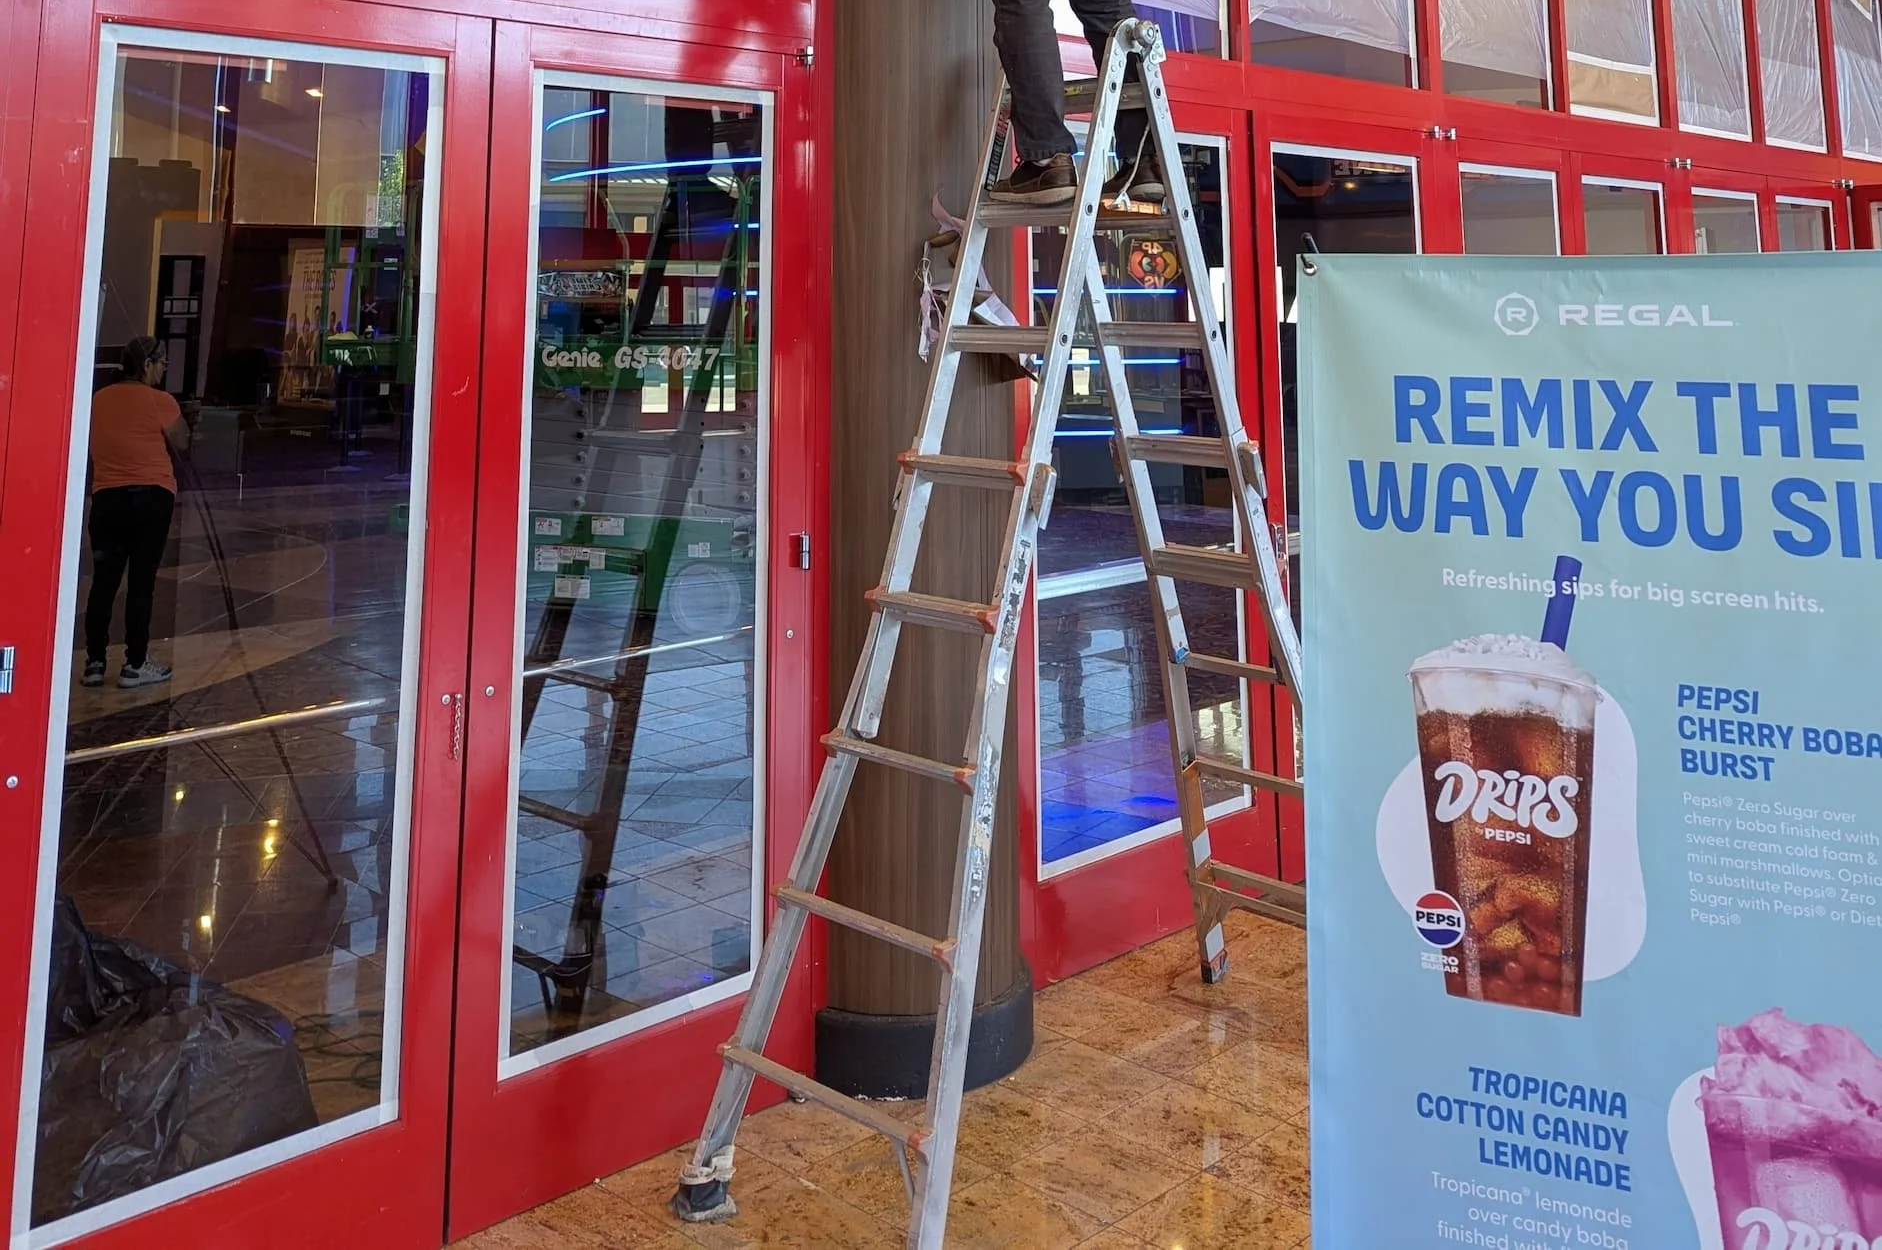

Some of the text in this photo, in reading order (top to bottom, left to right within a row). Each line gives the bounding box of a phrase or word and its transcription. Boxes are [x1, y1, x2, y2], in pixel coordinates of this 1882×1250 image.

[1558, 304, 1736, 328] REGAL
[541, 346, 602, 368] Genie
[1393, 375, 1866, 461] REMIX THE
[1348, 459, 1882, 560] WAY YOU SI
[1442, 568, 1825, 614] Refreshing sips for big screen hits.
[1678, 684, 1759, 715] PEPSI
[1678, 715, 1882, 759] CHERRY BOBA
[1680, 748, 1775, 781] BURST
[1736, 798, 1771, 814] Zero
[1774, 802, 1819, 821] Sugar
[1823, 810, 1857, 823] over
[1485, 828, 1532, 845] PEPSI
[1684, 812, 1880, 847] cherry boba finished with
[1686, 832, 1879, 866] sweet cream cold foam &
[1687, 851, 1717, 866] mini
[1720, 857, 1835, 881] marshmallows.
[1688, 870, 1704, 883] to
[1707, 874, 1781, 894] substitute
[1840, 888, 1876, 906] Zero
[1415, 910, 1461, 928] PEPSI
[1689, 888, 1733, 908] Sugar
[1736, 897, 1770, 912] with
[1830, 909, 1846, 922] or
[1850, 909, 1882, 927] Diet
[1420, 952, 1459, 966] ZERO
[1469, 1066, 1628, 1119] TROPICANA
[1416, 1092, 1630, 1155] COTTON CANDY
[1479, 1137, 1631, 1192] LEMONADE
[1535, 1191, 1633, 1228] lemonade
[1437, 1220, 1509, 1250] finished
[1468, 1207, 1629, 1250] over candy boba
